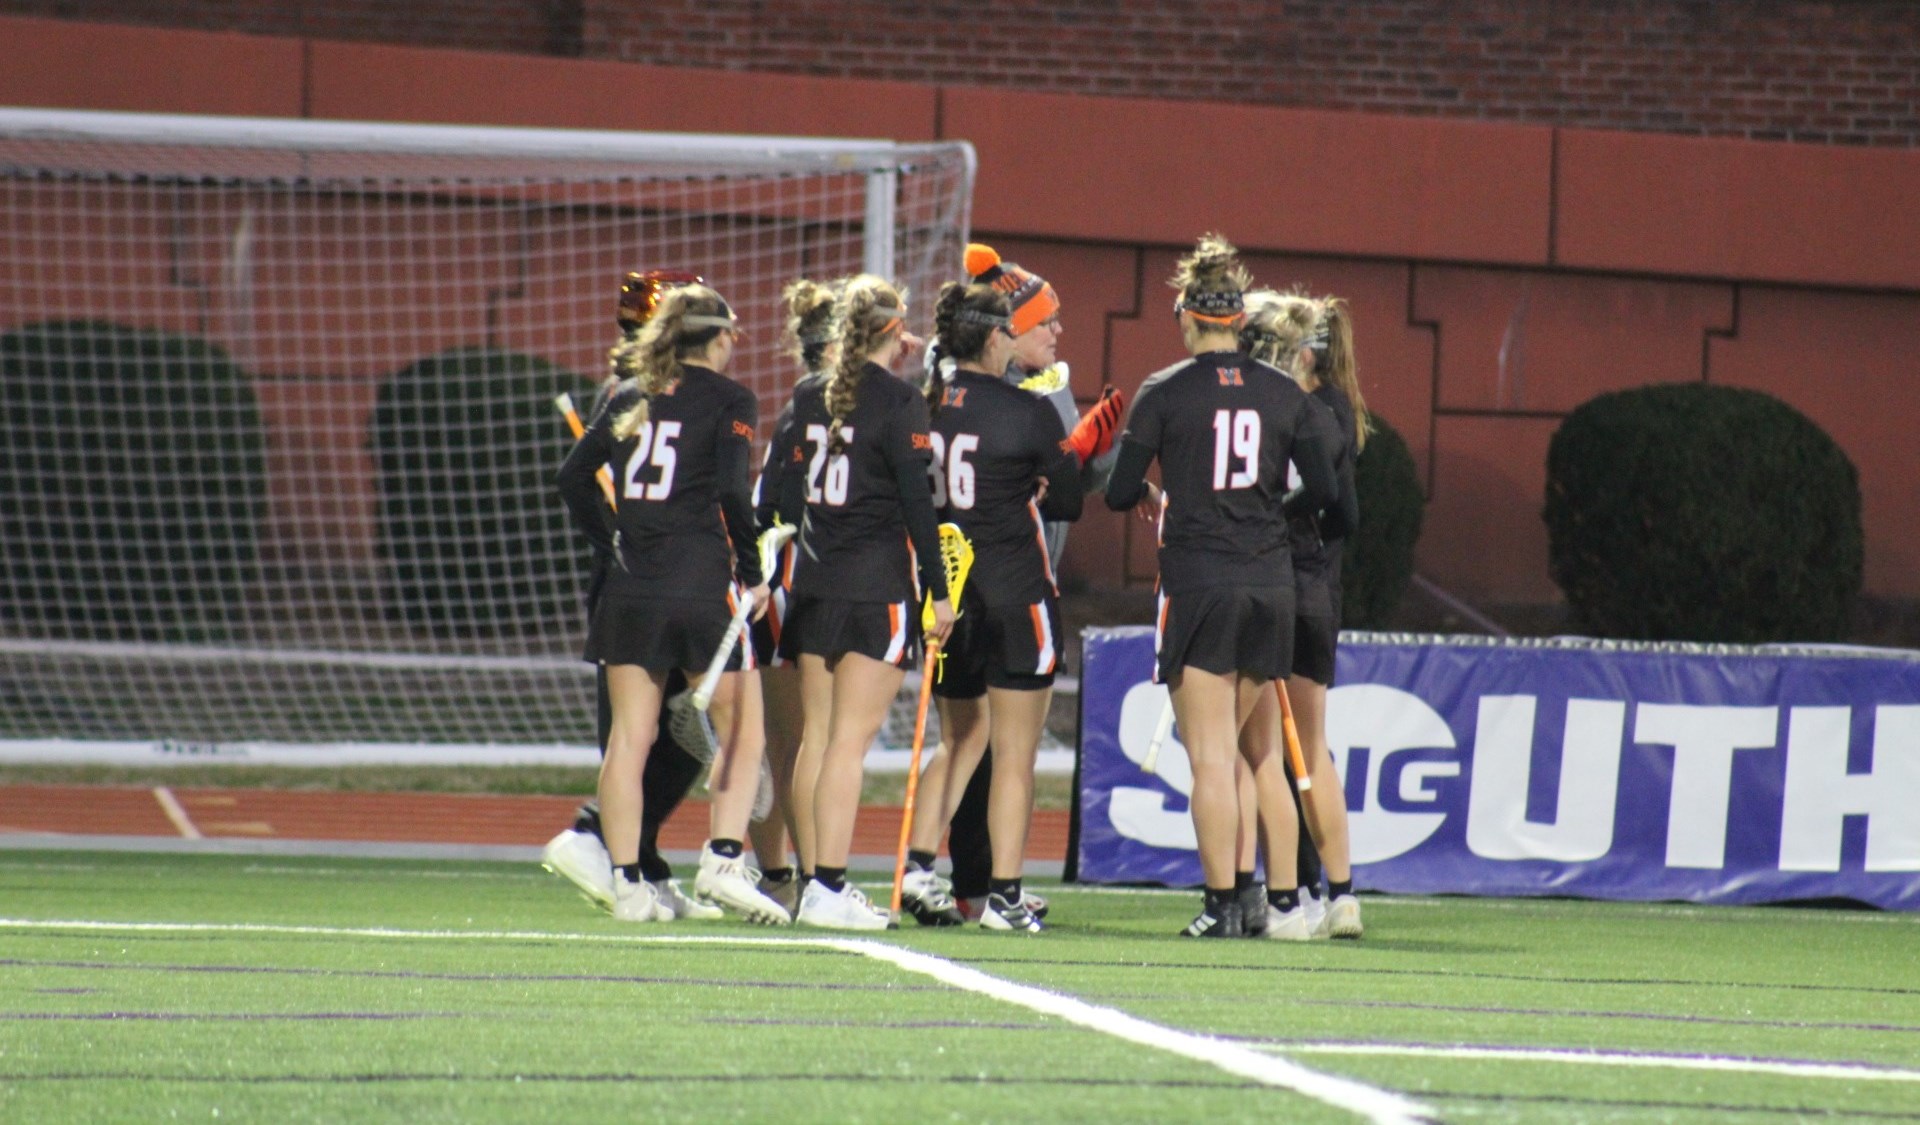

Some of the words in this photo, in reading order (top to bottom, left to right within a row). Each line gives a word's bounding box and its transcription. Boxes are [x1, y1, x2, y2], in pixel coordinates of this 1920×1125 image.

[624, 420, 682, 501] 25
[805, 423, 854, 507] 26
[1212, 408, 1261, 491] 19
[1330, 746, 1461, 814] IG
